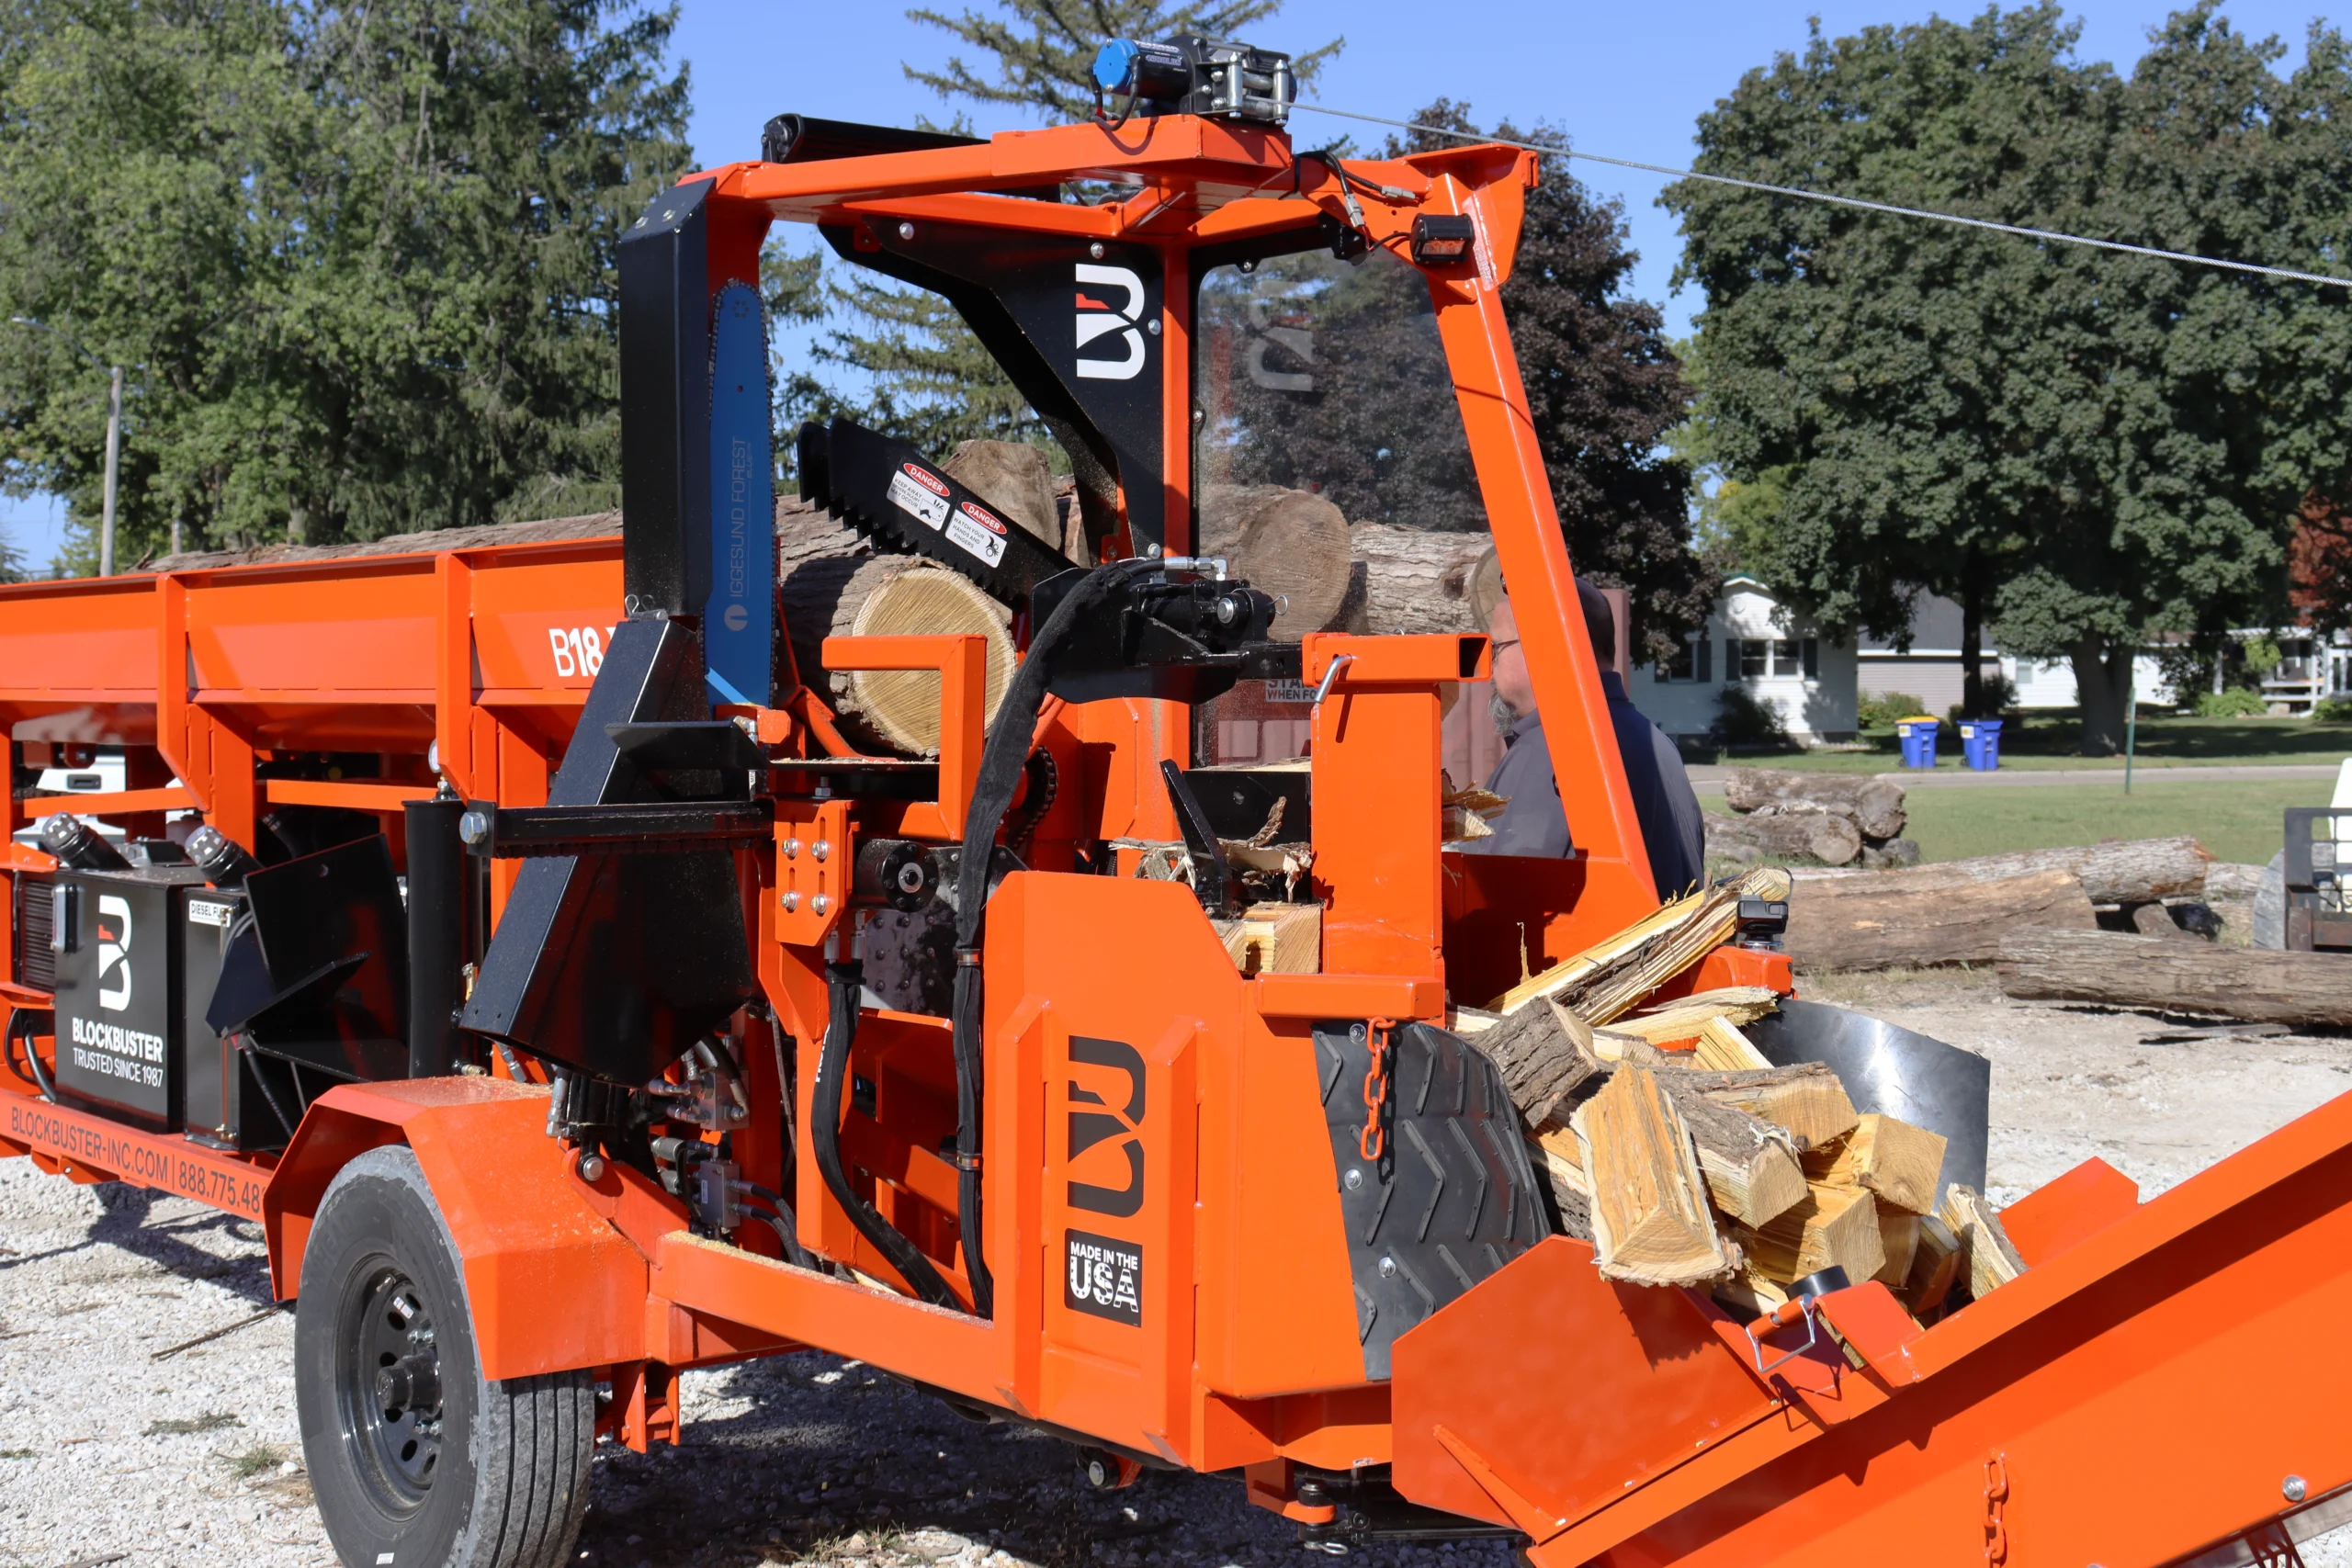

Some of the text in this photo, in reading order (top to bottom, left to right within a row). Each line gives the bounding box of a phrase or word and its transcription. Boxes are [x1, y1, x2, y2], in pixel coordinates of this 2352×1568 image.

[894, 478, 922, 499] KEEP AWAY
[910, 467, 944, 493] DANGER
[890, 487, 919, 508] MAY OCCUR
[730, 436, 746, 597] IGGESUND FOREST
[954, 517, 985, 540] WATCH YOUR
[967, 505, 1001, 531] DANGER
[952, 525, 980, 545] HANDS AND
[953, 533, 974, 548] FINGERS
[548, 626, 605, 677] B18
[1268, 689, 1301, 700] WHEN
[191, 903, 211, 917] DIESEL
[73, 1017, 164, 1063] BLOCKBUSTER
[74, 1047, 164, 1088] TRUSTED SINCE 1987
[11, 1106, 266, 1214] BLOCKBUSTER-INC.COM 888.775.48
[1070, 1241, 1138, 1270] MADE IN THE
[1069, 1255, 1139, 1313] USA
